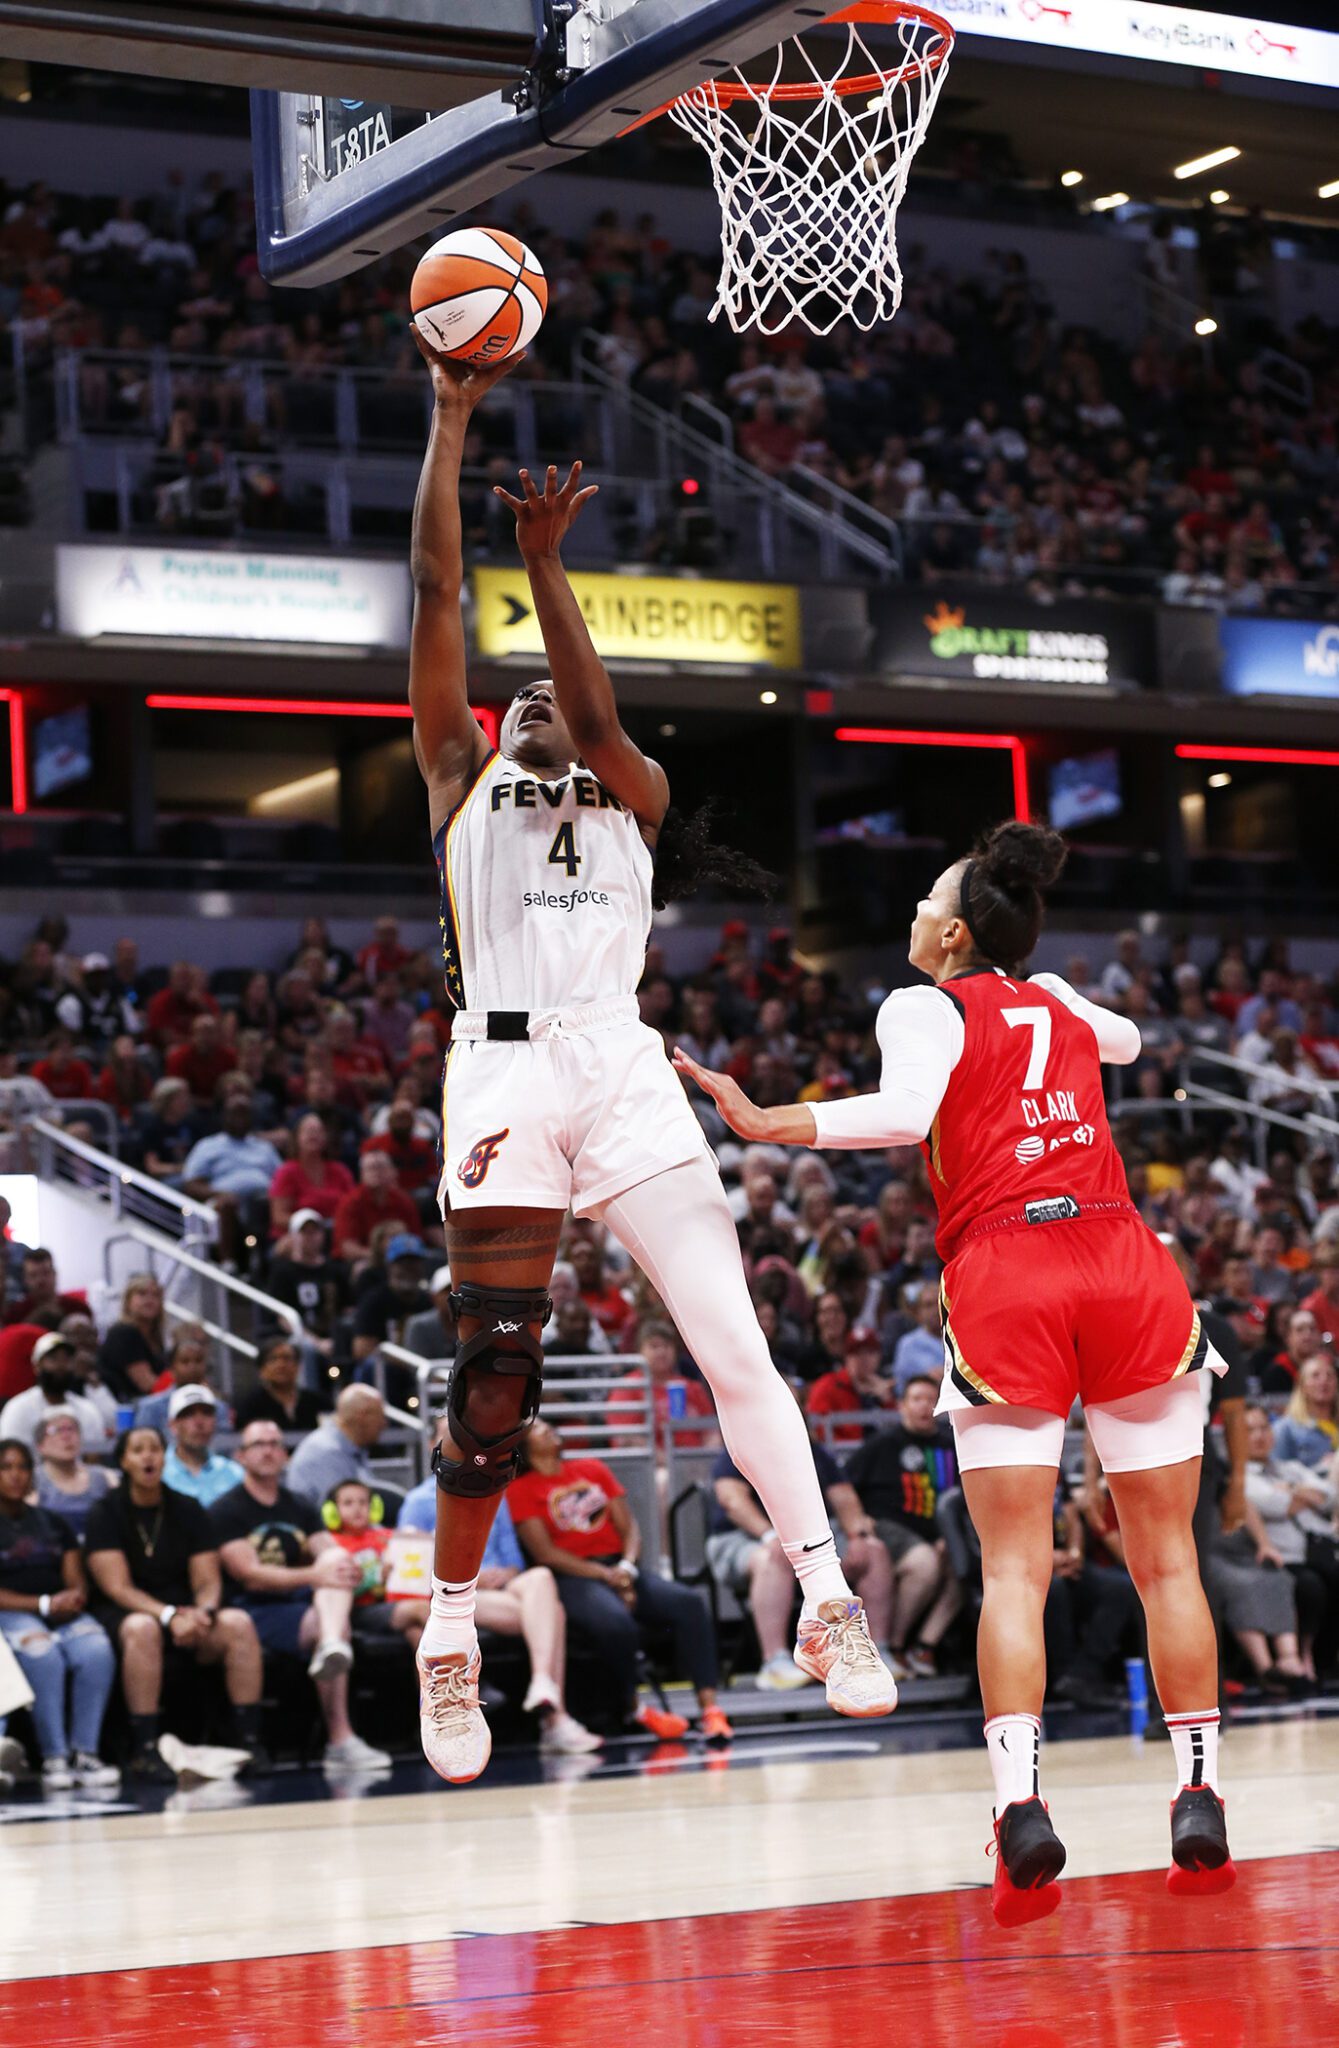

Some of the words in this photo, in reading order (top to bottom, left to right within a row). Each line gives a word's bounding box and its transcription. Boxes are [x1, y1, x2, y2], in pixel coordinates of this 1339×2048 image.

[1128, 20, 1236, 51] KeyBank
[161, 555, 239, 577] Peyton
[246, 560, 340, 587] Manning
[583, 593, 786, 648] AINBRIDGE
[547, 821, 582, 878] 4
[1000, 1005, 1052, 1091] 7
[1020, 1090, 1080, 1128] CLARK
